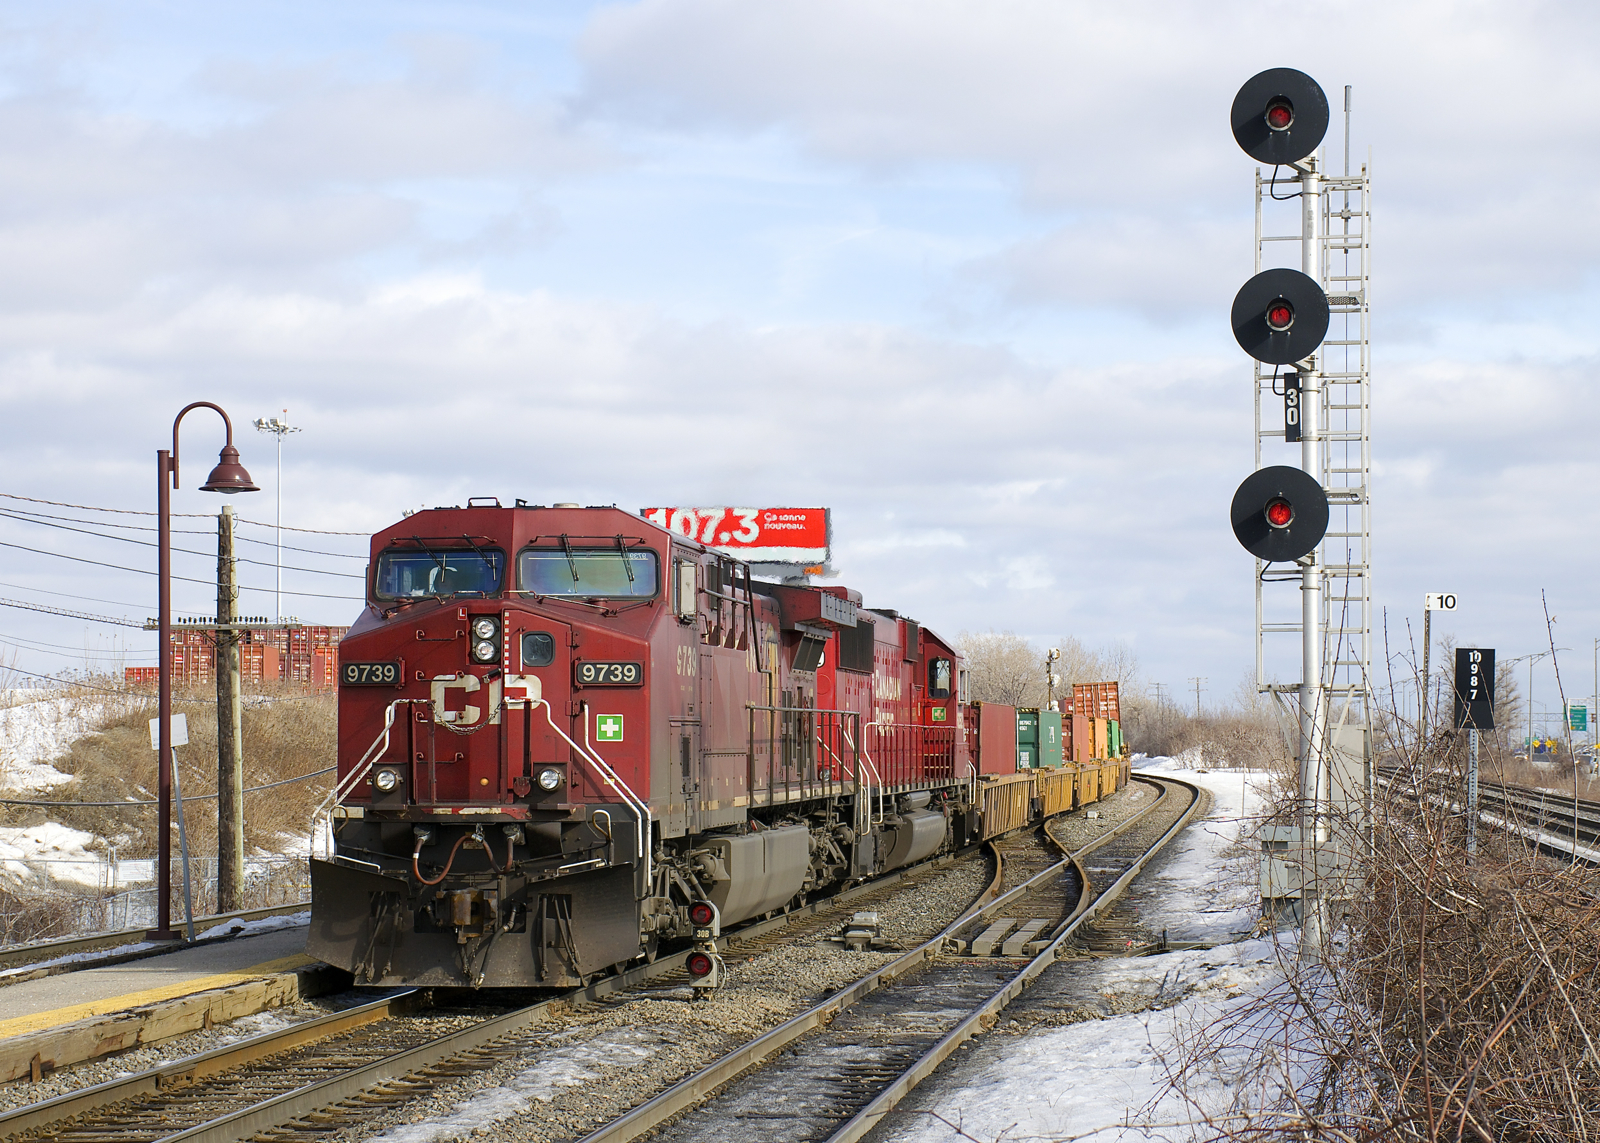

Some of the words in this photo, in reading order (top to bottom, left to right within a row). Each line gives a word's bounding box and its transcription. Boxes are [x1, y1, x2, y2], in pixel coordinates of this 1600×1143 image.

[1286, 388, 1299, 426] 30
[650, 508, 760, 544] 107.3
[1437, 595, 1456, 609] 10
[676, 644, 697, 677] 9739
[1468, 651, 1481, 663] 10
[347, 665, 395, 682] 9739
[582, 664, 637, 682] 9739
[1470, 663, 1478, 675] 9
[1470, 676, 1478, 687] 8
[431, 674, 542, 725] CP
[1470, 689, 1477, 700] 7
